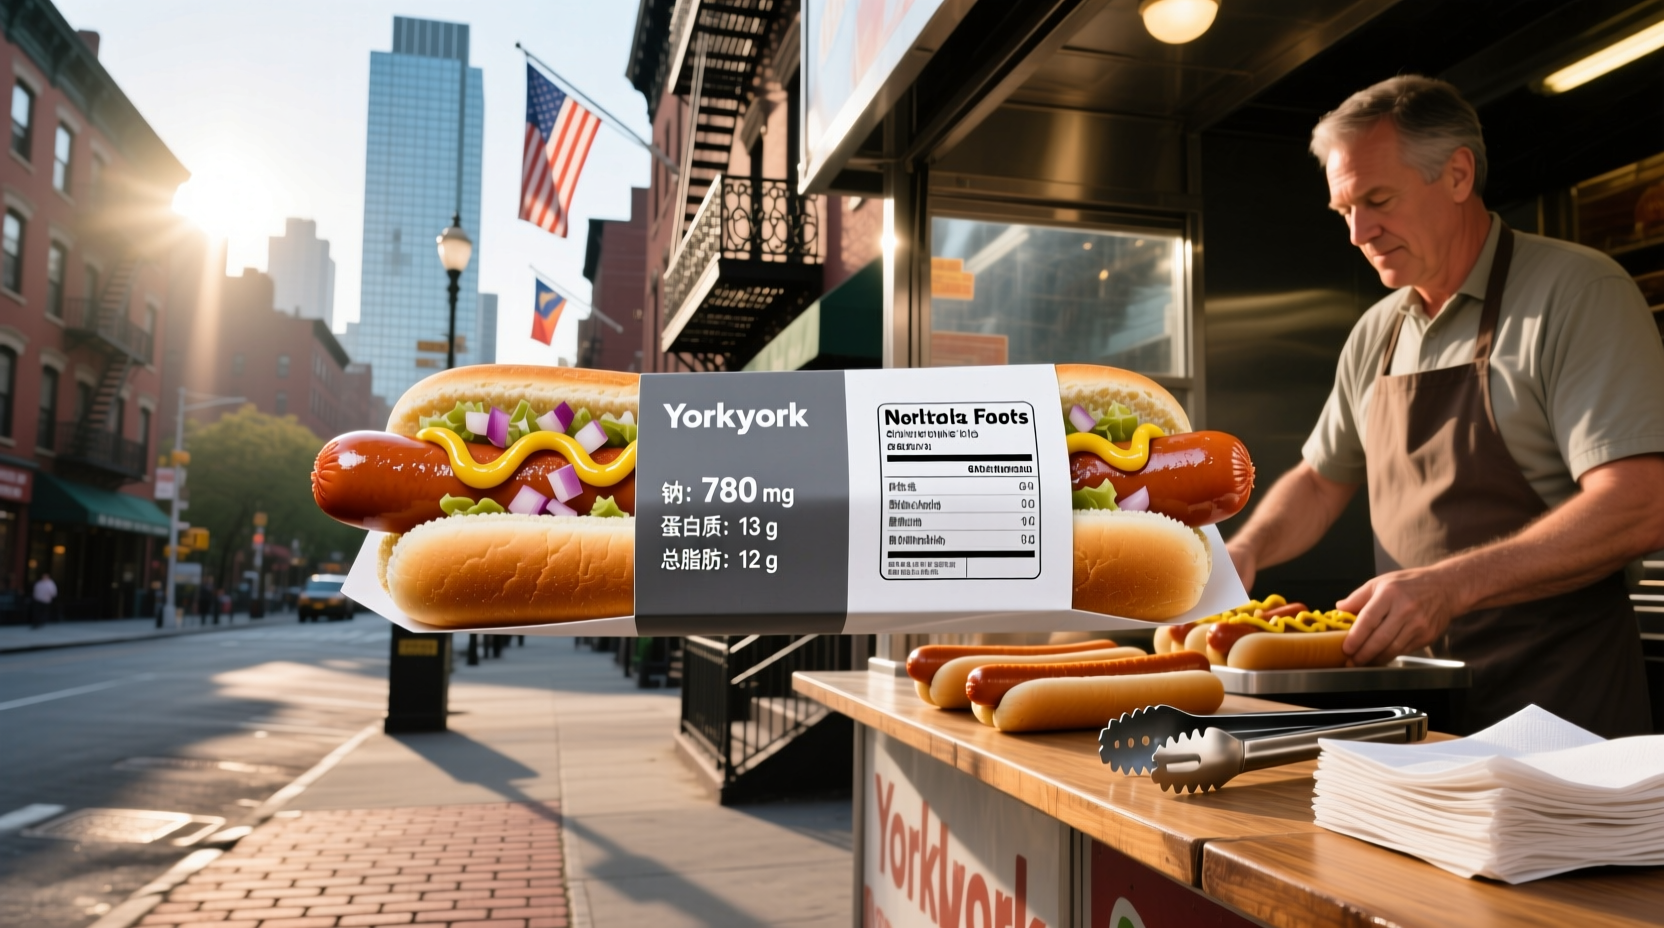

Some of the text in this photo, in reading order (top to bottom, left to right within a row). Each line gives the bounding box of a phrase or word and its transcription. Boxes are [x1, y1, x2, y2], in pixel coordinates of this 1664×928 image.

[663, 402, 809, 435] Yorkyork
[701, 477, 758, 503] 780
[762, 487, 795, 508] mg
[739, 517, 761, 536] 13
[766, 521, 778, 541] g
[739, 550, 761, 569] 12
[766, 554, 778, 574] g
